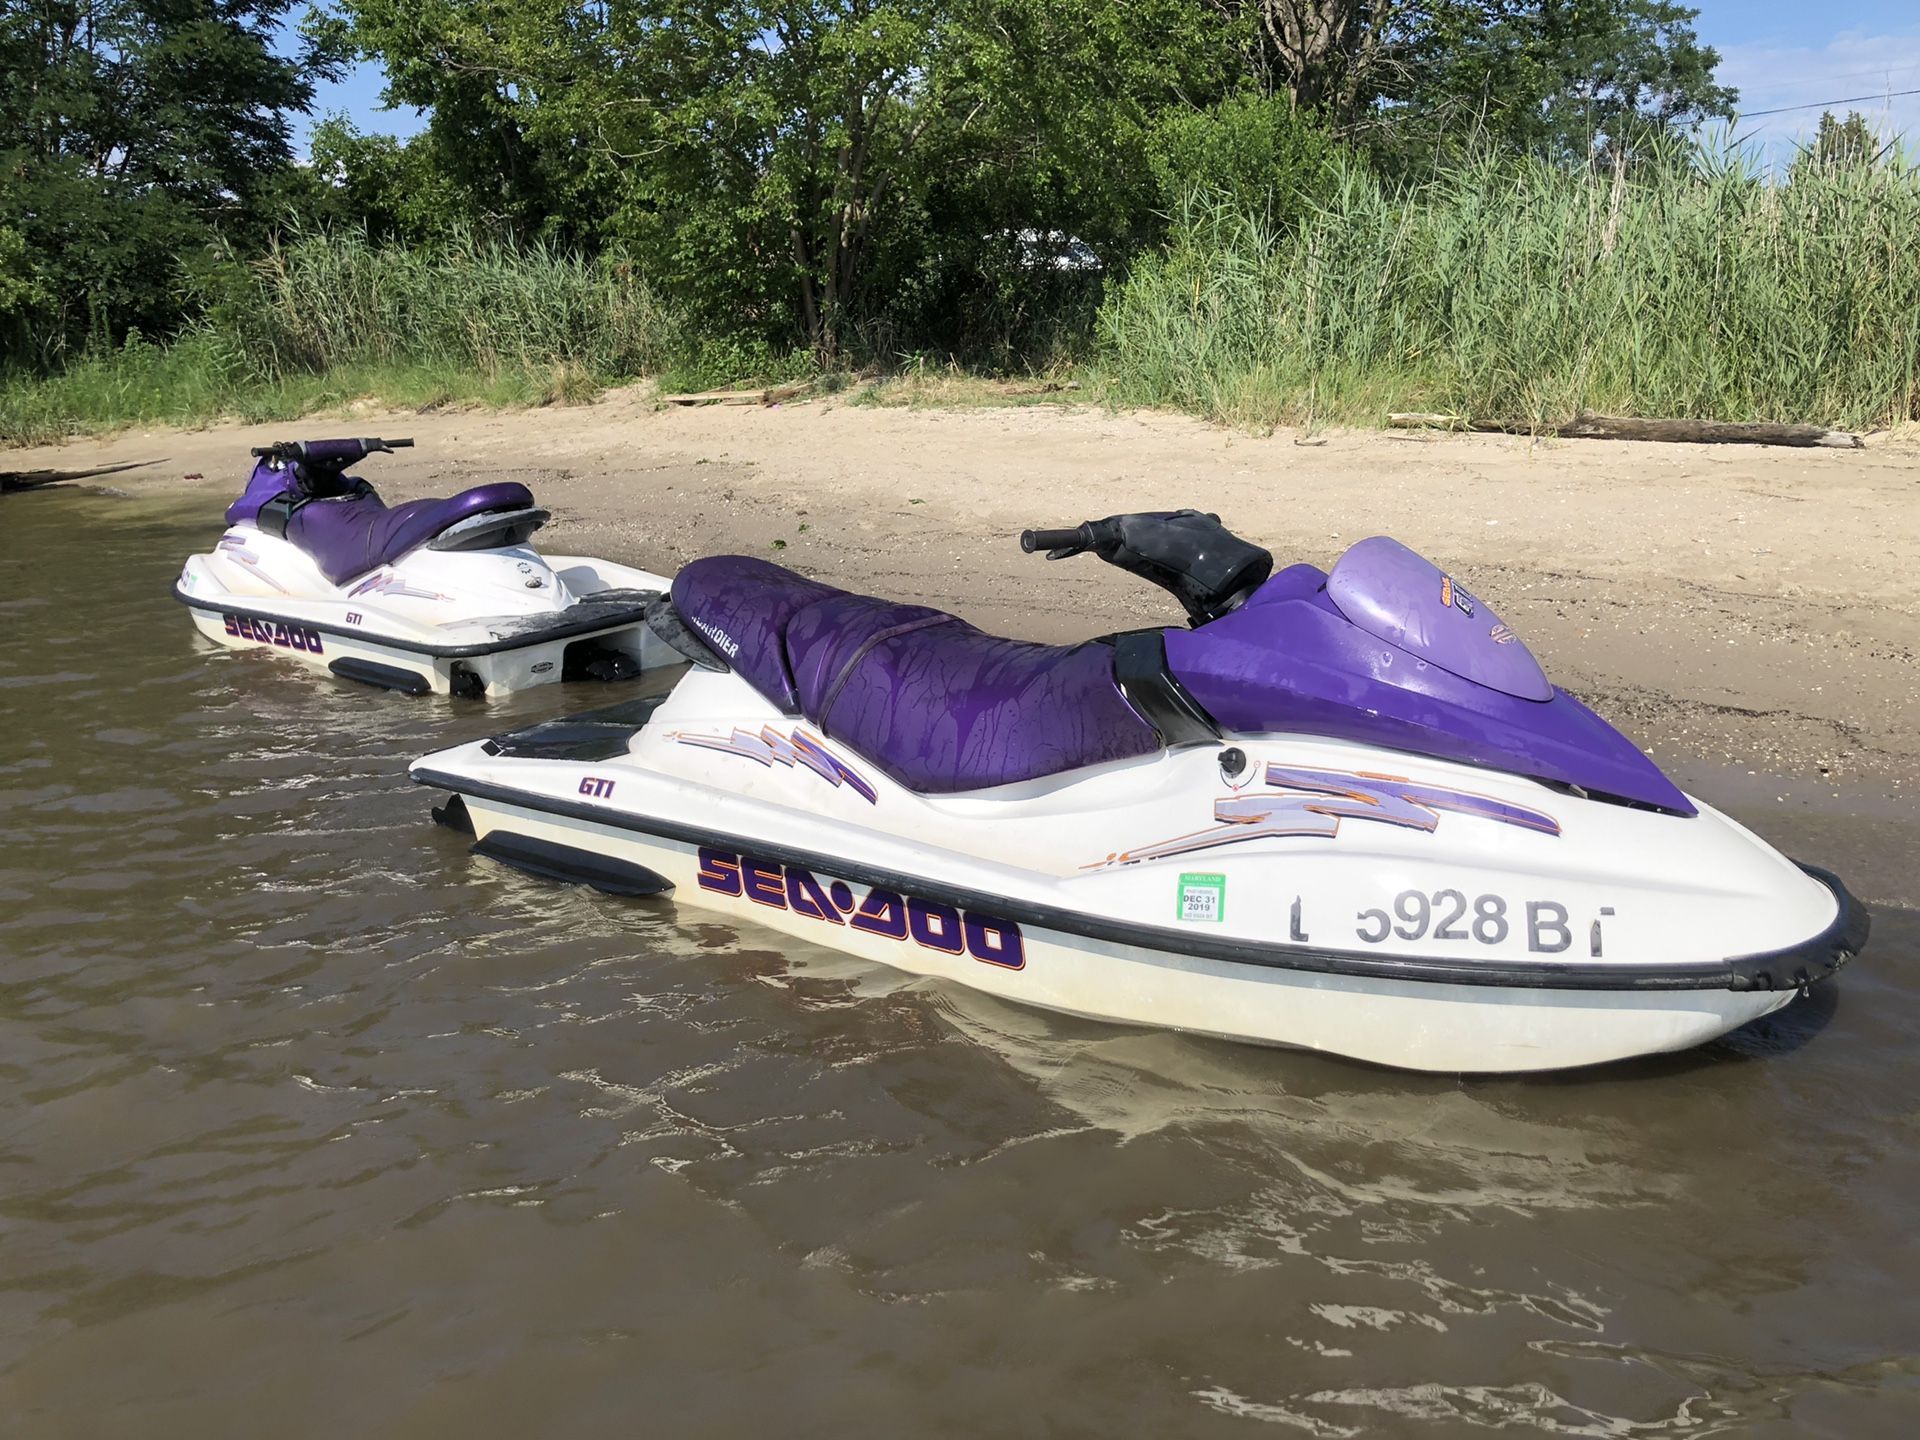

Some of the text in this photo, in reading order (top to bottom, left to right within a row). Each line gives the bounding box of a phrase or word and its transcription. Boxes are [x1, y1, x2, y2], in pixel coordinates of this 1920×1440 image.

[346, 612, 362, 625] GTI
[578, 777, 616, 799] GTI
[1184, 895, 1216, 904] DEC 31
[1188, 903, 1210, 911] 2019
